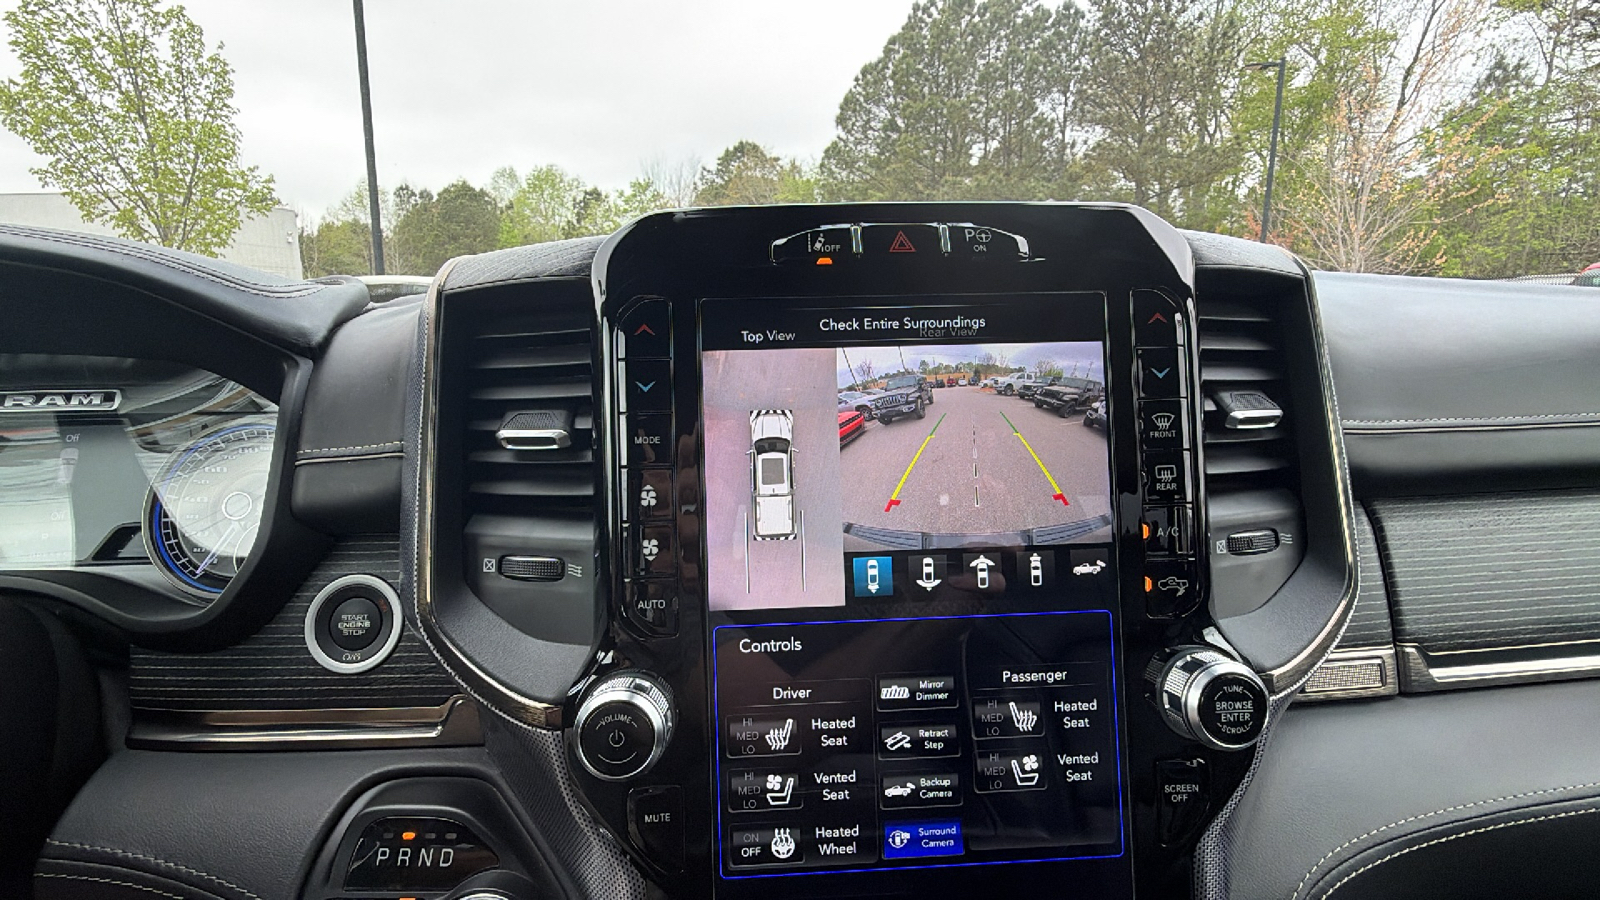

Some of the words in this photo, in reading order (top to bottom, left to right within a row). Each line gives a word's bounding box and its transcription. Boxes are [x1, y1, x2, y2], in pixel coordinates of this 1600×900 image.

[825, 244, 841, 253] OFF
[973, 244, 987, 252] ON
[819, 318, 860, 331] Check
[864, 317, 900, 330] Entire
[903, 315, 986, 330] Surroundings
[920, 327, 946, 338] Rear
[950, 325, 978, 337] View
[741, 330, 764, 344] Top
[766, 330, 796, 342] View
[4, 393, 104, 407] RAM
[65, 434, 81, 443] Off
[1149, 430, 1177, 439] FRONT
[634, 436, 661, 445] MODE
[1156, 482, 1178, 491] REAR
[1156, 526, 1180, 538] A/C
[637, 599, 666, 609] AUTO
[338, 621, 371, 629] ENGINE
[739, 636, 803, 653] Controls
[1002, 670, 1068, 684] Passenger
[919, 680, 945, 689] Mirror
[1222, 684, 1244, 694] TUNE
[772, 687, 812, 700] Driver
[915, 691, 949, 701] Dimmer
[987, 700, 998, 709] HI
[1054, 699, 1098, 712] Heated
[1215, 700, 1253, 710] BROWSE
[600, 713, 633, 726] VOLUME
[742, 718, 753, 727] HI
[981, 714, 1004, 722] MED
[1063, 716, 1090, 729] Seat
[1221, 713, 1251, 722] ENTER
[811, 716, 856, 730] Heated
[918, 729, 949, 738] Retract
[986, 727, 1000, 736] LO
[1221, 724, 1251, 734] SCROLL
[736, 732, 759, 741] MED
[821, 734, 848, 747] Seat
[741, 745, 755, 754] LO
[924, 740, 944, 750] Step
[989, 753, 1000, 762] HI
[1057, 752, 1099, 765] Vented
[744, 772, 755, 781] HI
[984, 767, 1006, 776] MED
[1066, 770, 1093, 782] Seat
[814, 770, 856, 784] Vented
[920, 778, 951, 788] Backup
[989, 780, 1002, 789] LO
[738, 786, 760, 795] MED
[1164, 784, 1199, 793] SCREEN
[822, 788, 850, 800] Seat
[919, 790, 952, 799] Camera
[1171, 794, 1188, 802] OFF
[743, 800, 757, 809] LO
[644, 813, 671, 823] MUTE
[815, 825, 859, 838] Heated
[918, 826, 957, 836] Surround
[743, 834, 759, 842] ON
[921, 838, 955, 848] Camera
[741, 848, 761, 857] OFF
[818, 842, 857, 855] Wheel
